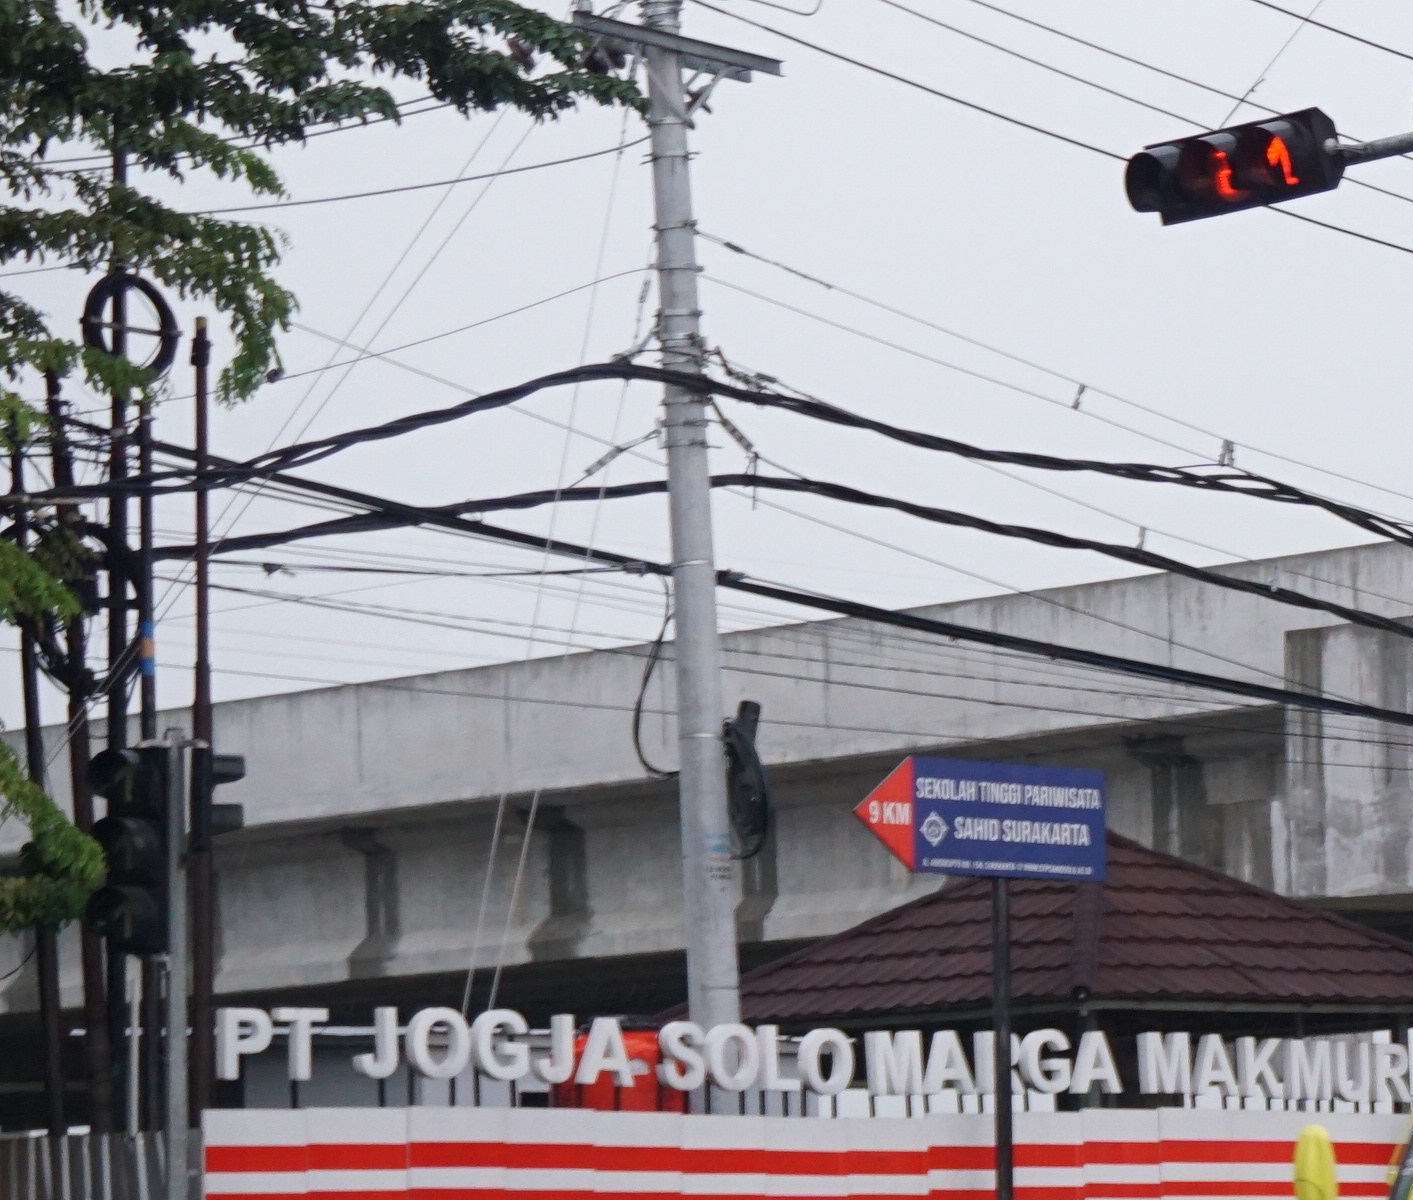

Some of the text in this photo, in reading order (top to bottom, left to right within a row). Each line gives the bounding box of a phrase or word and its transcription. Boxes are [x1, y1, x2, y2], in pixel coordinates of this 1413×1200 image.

[916, 776, 1101, 810] SEKOLAH TINGGI PARIWISATA
[868, 800, 912, 825] 9 KM
[954, 815, 1091, 847] SAHID SURAKARTA
[214, 1007, 1413, 1103] PT JOGJA SOLO MARGA MAKMUR
